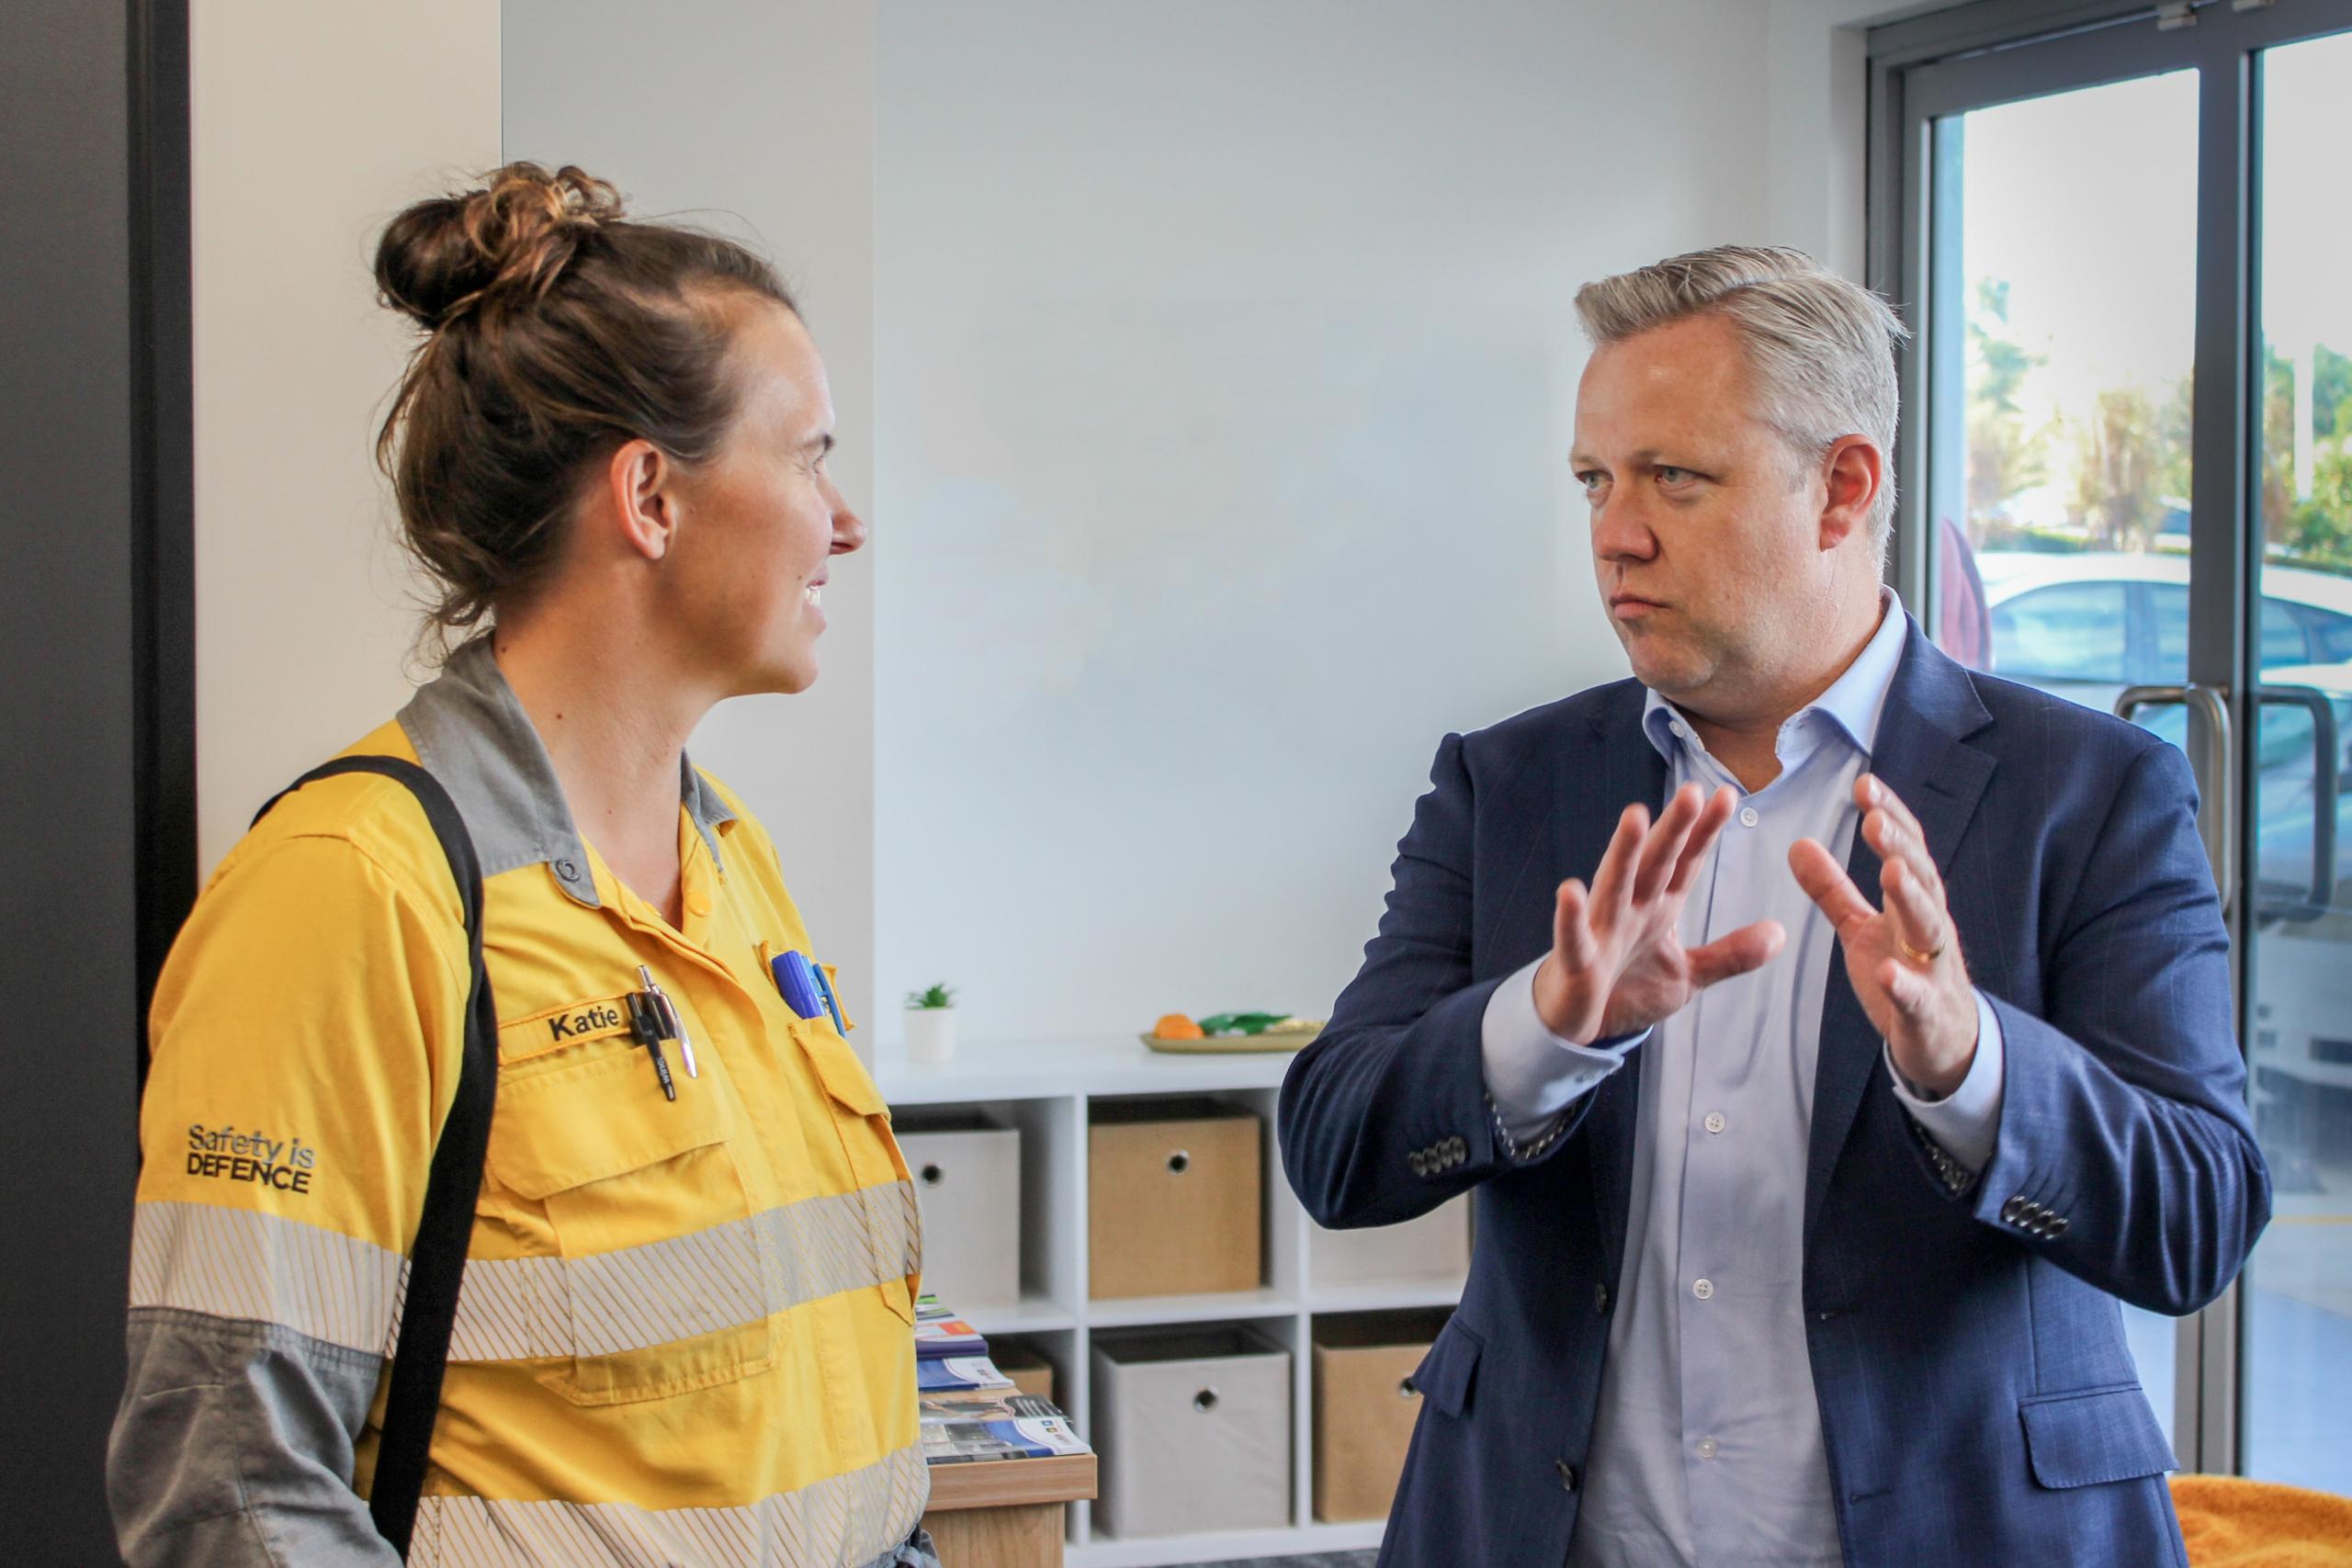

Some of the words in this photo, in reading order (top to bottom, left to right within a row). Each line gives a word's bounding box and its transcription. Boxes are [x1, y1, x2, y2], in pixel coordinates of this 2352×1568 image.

[548, 1005, 619, 1042] Katie
[188, 1124, 283, 1166] Safety
[289, 1137, 314, 1168] is
[187, 1152, 311, 1194] DEFENCE
